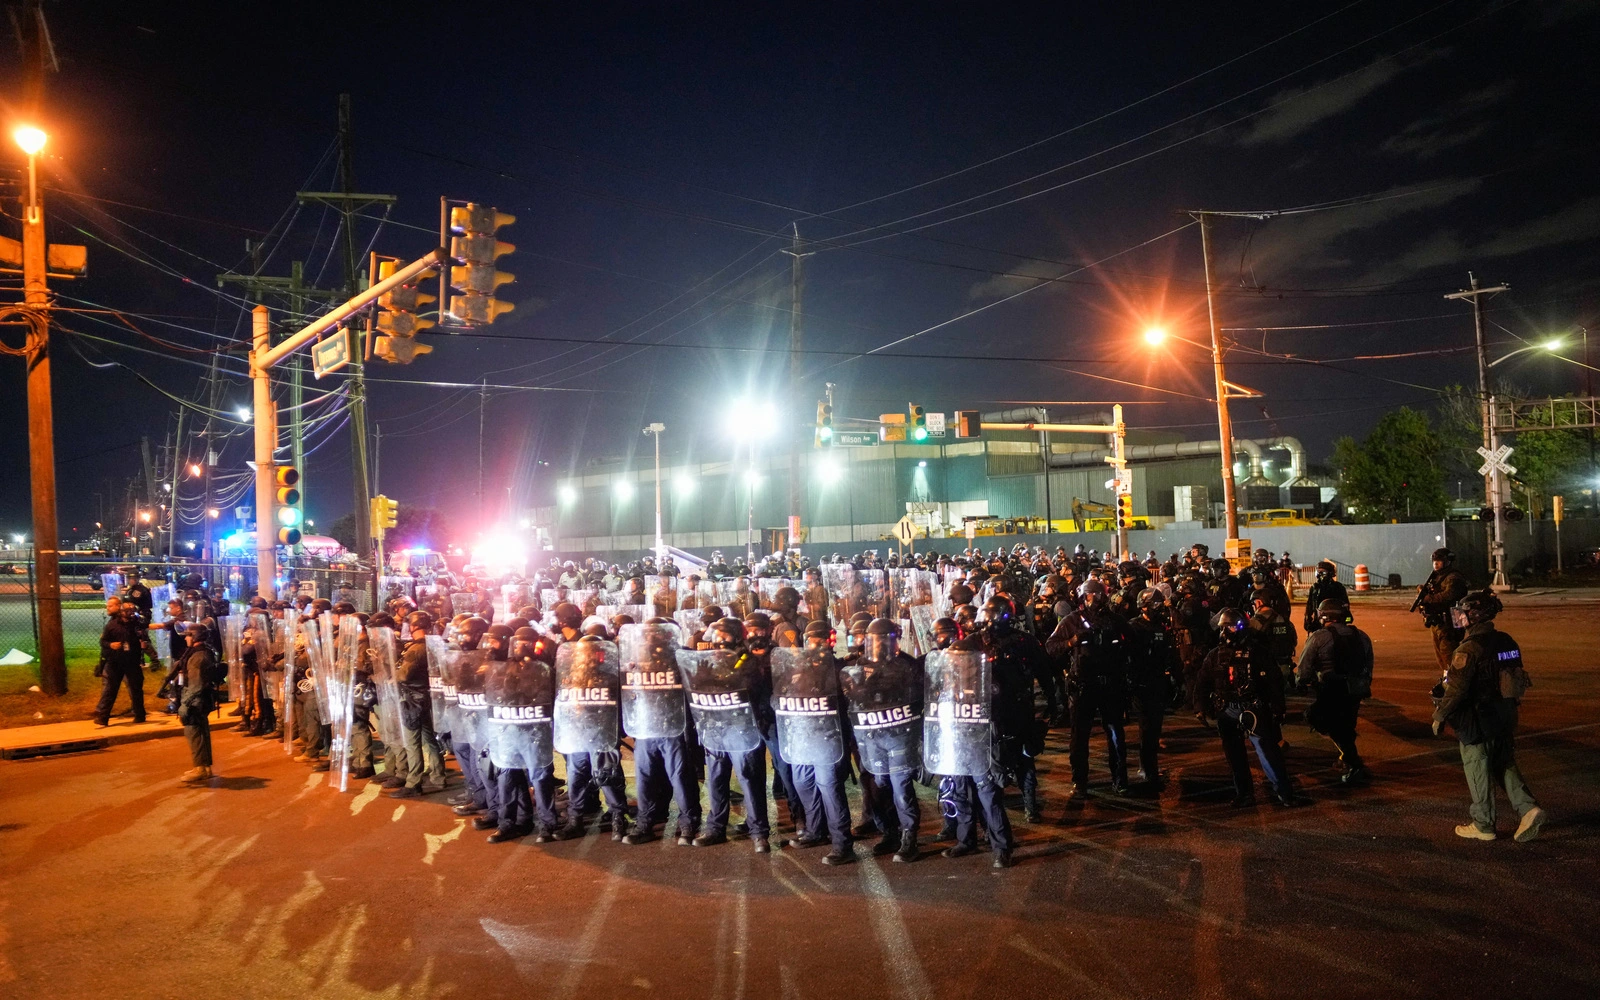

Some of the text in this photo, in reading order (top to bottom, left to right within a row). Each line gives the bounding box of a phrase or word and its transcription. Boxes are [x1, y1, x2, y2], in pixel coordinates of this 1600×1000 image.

[1498, 650, 1520, 660] POLICE
[626, 672, 674, 685] POLICE
[561, 688, 609, 701] POLICE
[691, 692, 741, 706] POLICE
[779, 697, 828, 711] POLICE
[493, 706, 544, 719] POLICE
[857, 705, 912, 725] POLICE
